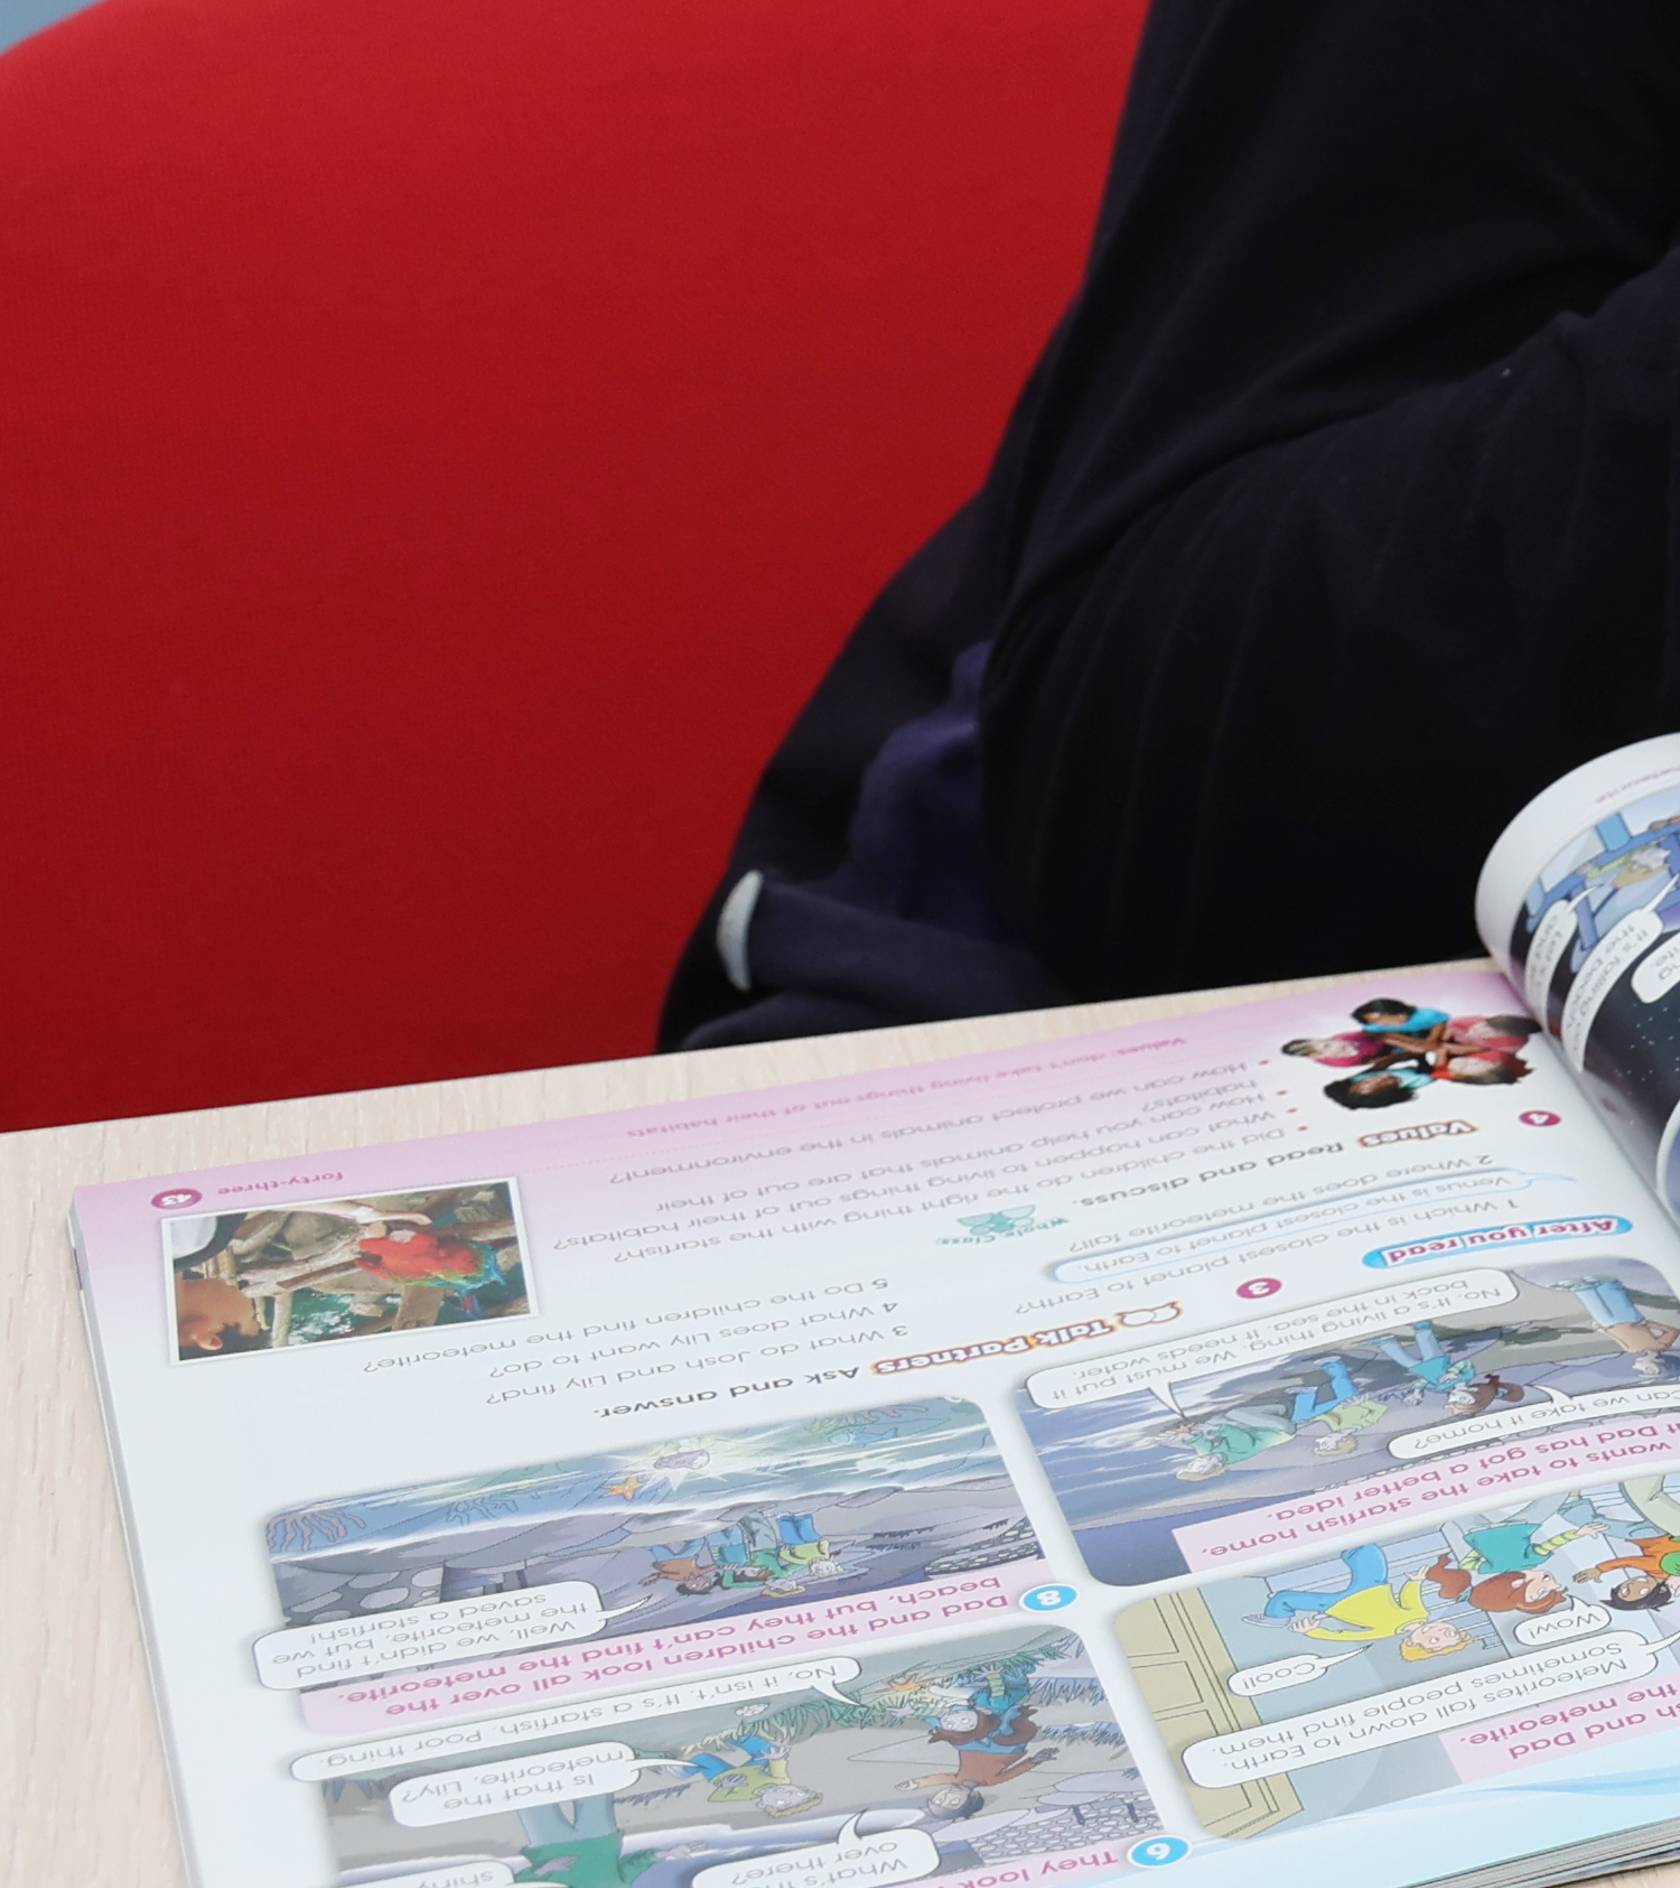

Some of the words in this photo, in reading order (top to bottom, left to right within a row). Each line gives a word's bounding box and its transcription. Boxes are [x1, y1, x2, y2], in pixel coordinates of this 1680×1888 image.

[1360, 1121, 1473, 1147] Values
[1266, 1141, 1344, 1167] Read
[217, 1171, 344, 1195] forty-three
[1198, 1161, 1258, 1183] and
[160, 1191, 193, 1207] 43
[1080, 1176, 1189, 1207] discuss.
[1467, 1226, 1531, 1246] you
[1535, 1219, 1614, 1238] After
[1386, 1240, 1458, 1263] read
[1247, 1280, 1272, 1295] 3
[1033, 1320, 1112, 1347] Talk
[874, 1337, 1030, 1376] Partners
[805, 1366, 860, 1385] Ask
[728, 1377, 794, 1399] and
[594, 1390, 718, 1418] answer.
[1535, 1436, 1590, 1454] has
[1596, 1425, 1659, 1445] Dad
[1479, 1446, 1527, 1470] got
[1548, 1456, 1580, 1470] to
[1585, 1441, 1672, 1463] wants
[1448, 1463, 1470, 1475] a
[1476, 1464, 1542, 1487] take
[1354, 1470, 1442, 1501] better
[1421, 1482, 1470, 1502] the
[1267, 1496, 1345, 1521] idea.
[1305, 1497, 1412, 1533] starfish
[1202, 1528, 1298, 1557] home,
[889, 1577, 1001, 1605] beach,
[1032, 1588, 1066, 1610] 8
[825, 1600, 878, 1620] but
[941, 1594, 1009, 1618] Dad
[747, 1611, 816, 1632] they
[806, 1623, 859, 1640] the
[867, 1609, 931, 1632] and
[1528, 1612, 1601, 1640] Wow!
[654, 1625, 736, 1651] can't
[663, 1634, 796, 1665] children
[518, 1655, 571, 1672] the
[581, 1642, 644, 1664] find
[583, 1659, 653, 1681] look
[1243, 1661, 1316, 1690] Cool!
[1471, 1642, 1622, 1688] Sometimes
[340, 1666, 506, 1702] meteorite.
[532, 1674, 572, 1692] all
[1483, 1658, 1627, 1703] Meteorites
[450, 1683, 521, 1705] over
[1363, 1680, 1463, 1718] people
[1626, 1683, 1678, 1703] the
[385, 1697, 439, 1716] the
[1435, 1698, 1478, 1719] fall
[1301, 1713, 1356, 1738] find
[1348, 1711, 1428, 1740] down
[1461, 1698, 1618, 1745] meteorite.
[1584, 1713, 1647, 1740] and
[1212, 1730, 1294, 1756] them.
[1312, 1735, 1342, 1749] to
[1508, 1731, 1577, 1760] Dad
[1230, 1744, 1306, 1770] Earth.
[1039, 1850, 1119, 1875] They
[1143, 1843, 1175, 1863] 6
[963, 1868, 1030, 1888] look
